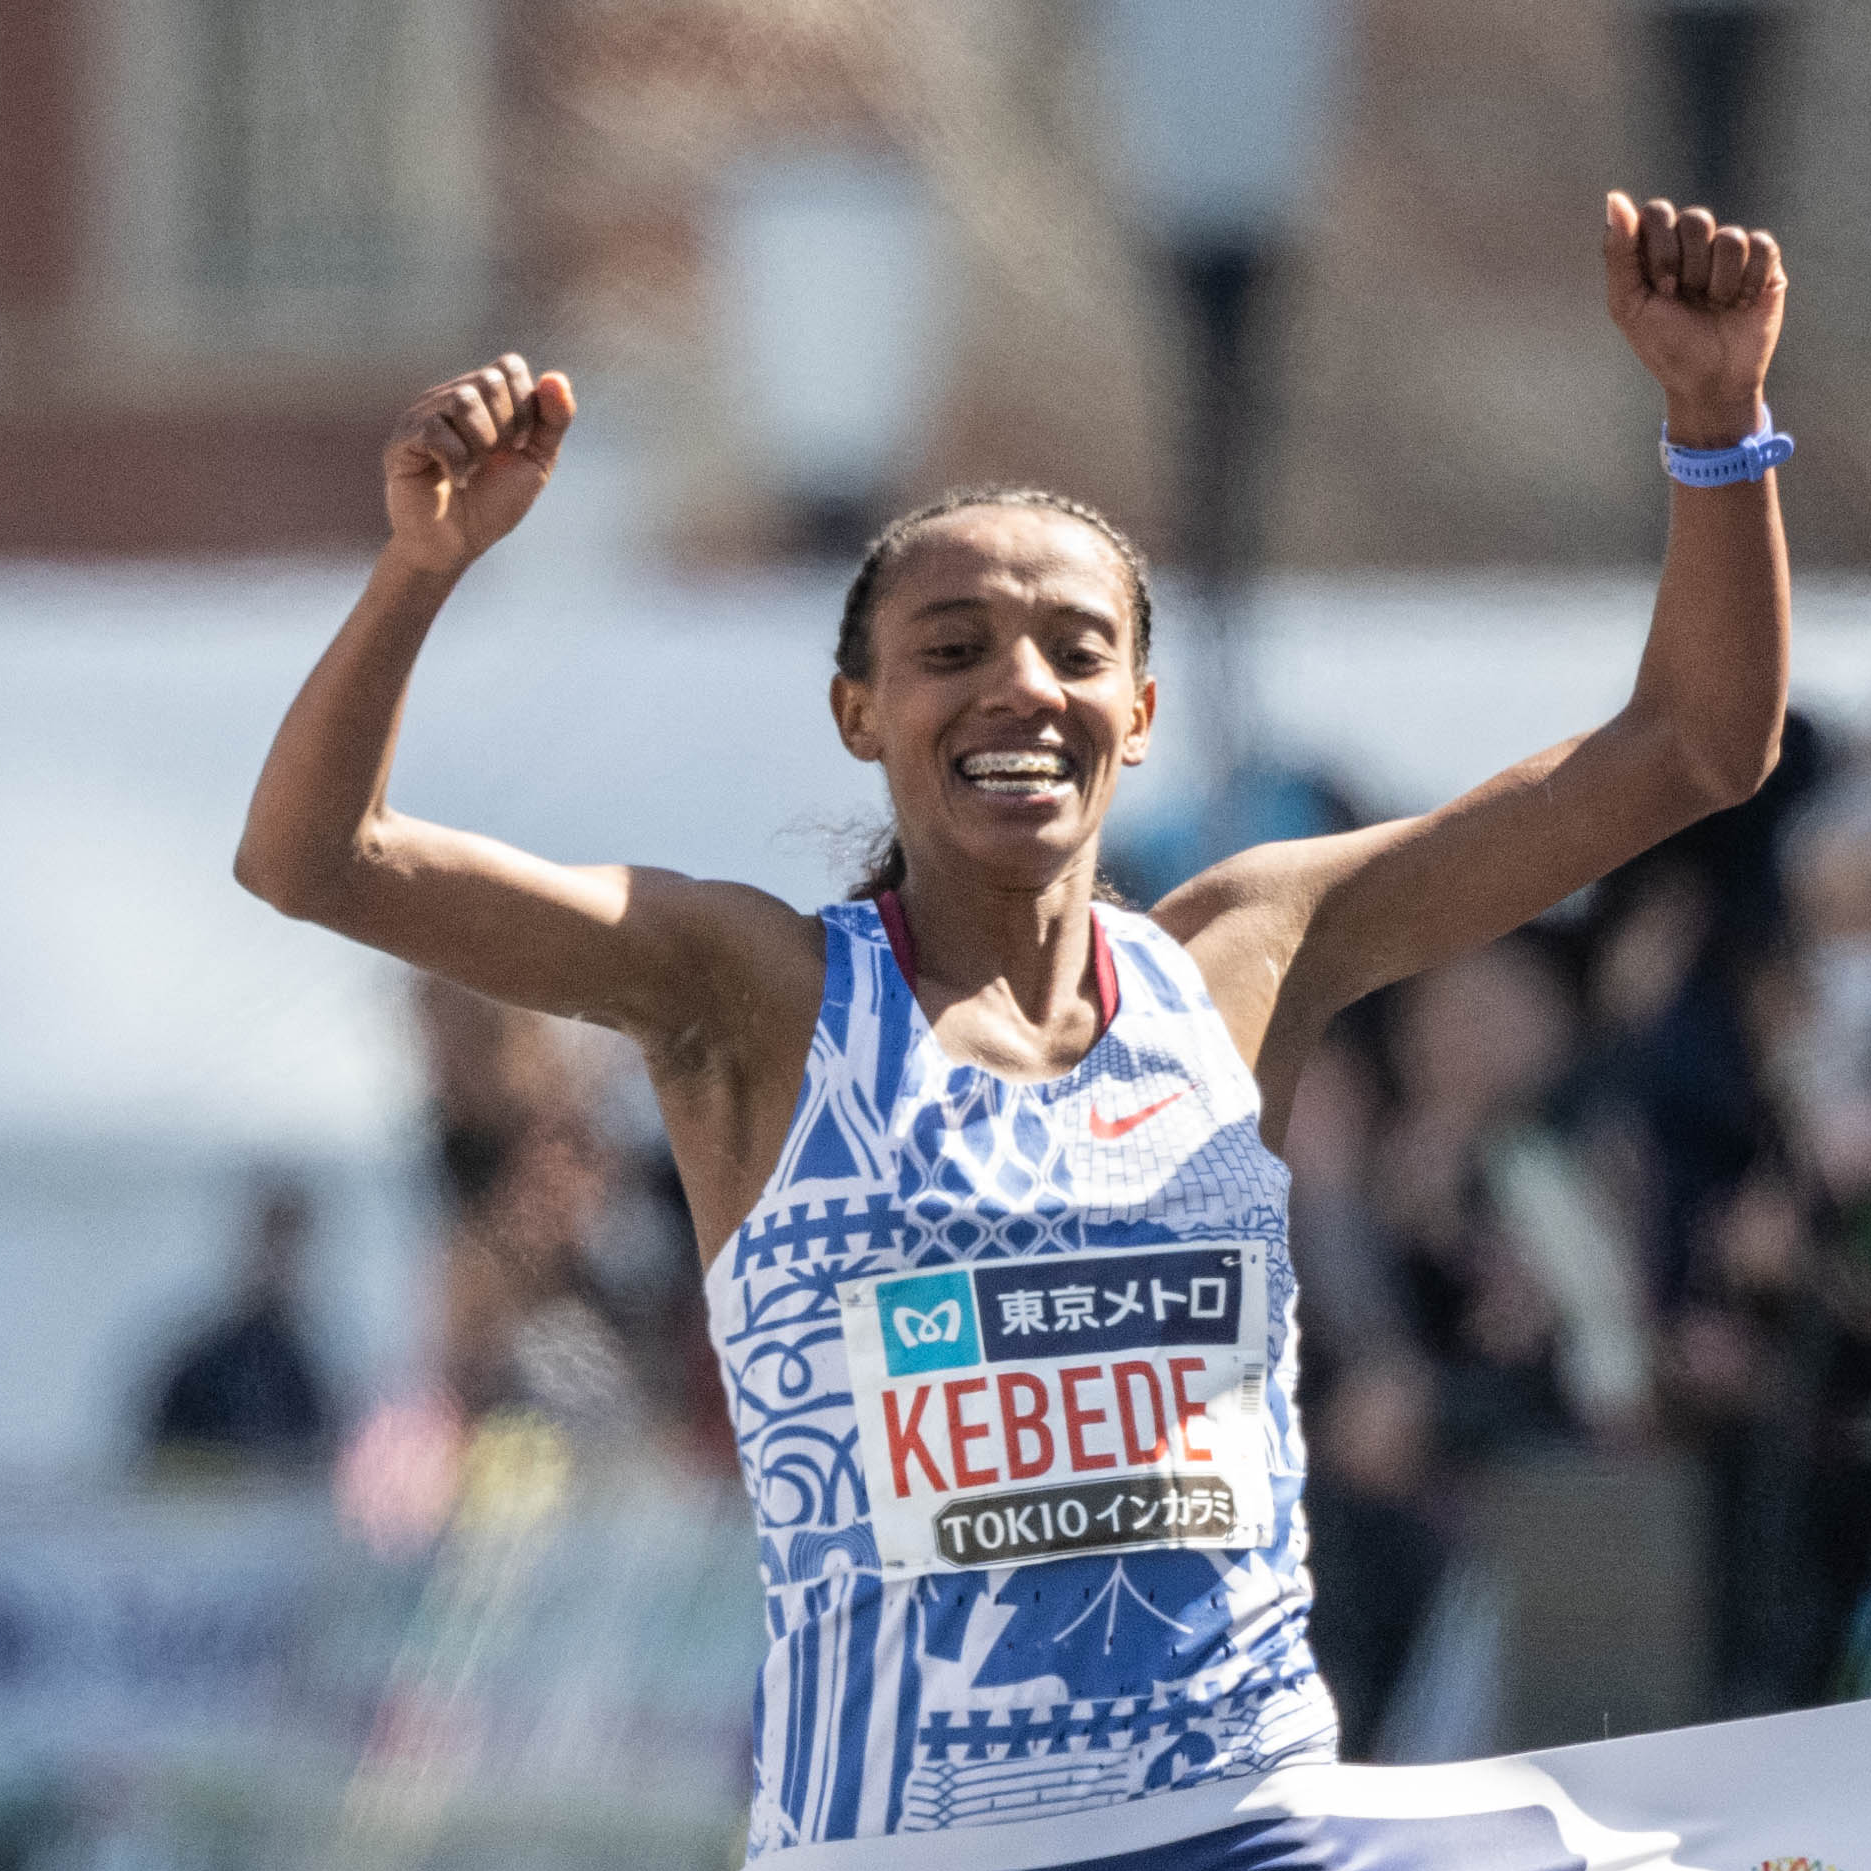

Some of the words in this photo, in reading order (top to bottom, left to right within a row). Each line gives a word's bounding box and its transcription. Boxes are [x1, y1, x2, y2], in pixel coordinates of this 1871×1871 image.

[996, 1277, 1226, 1336] 東京メトロ
[881, 1356, 1213, 1499] KEBEDE
